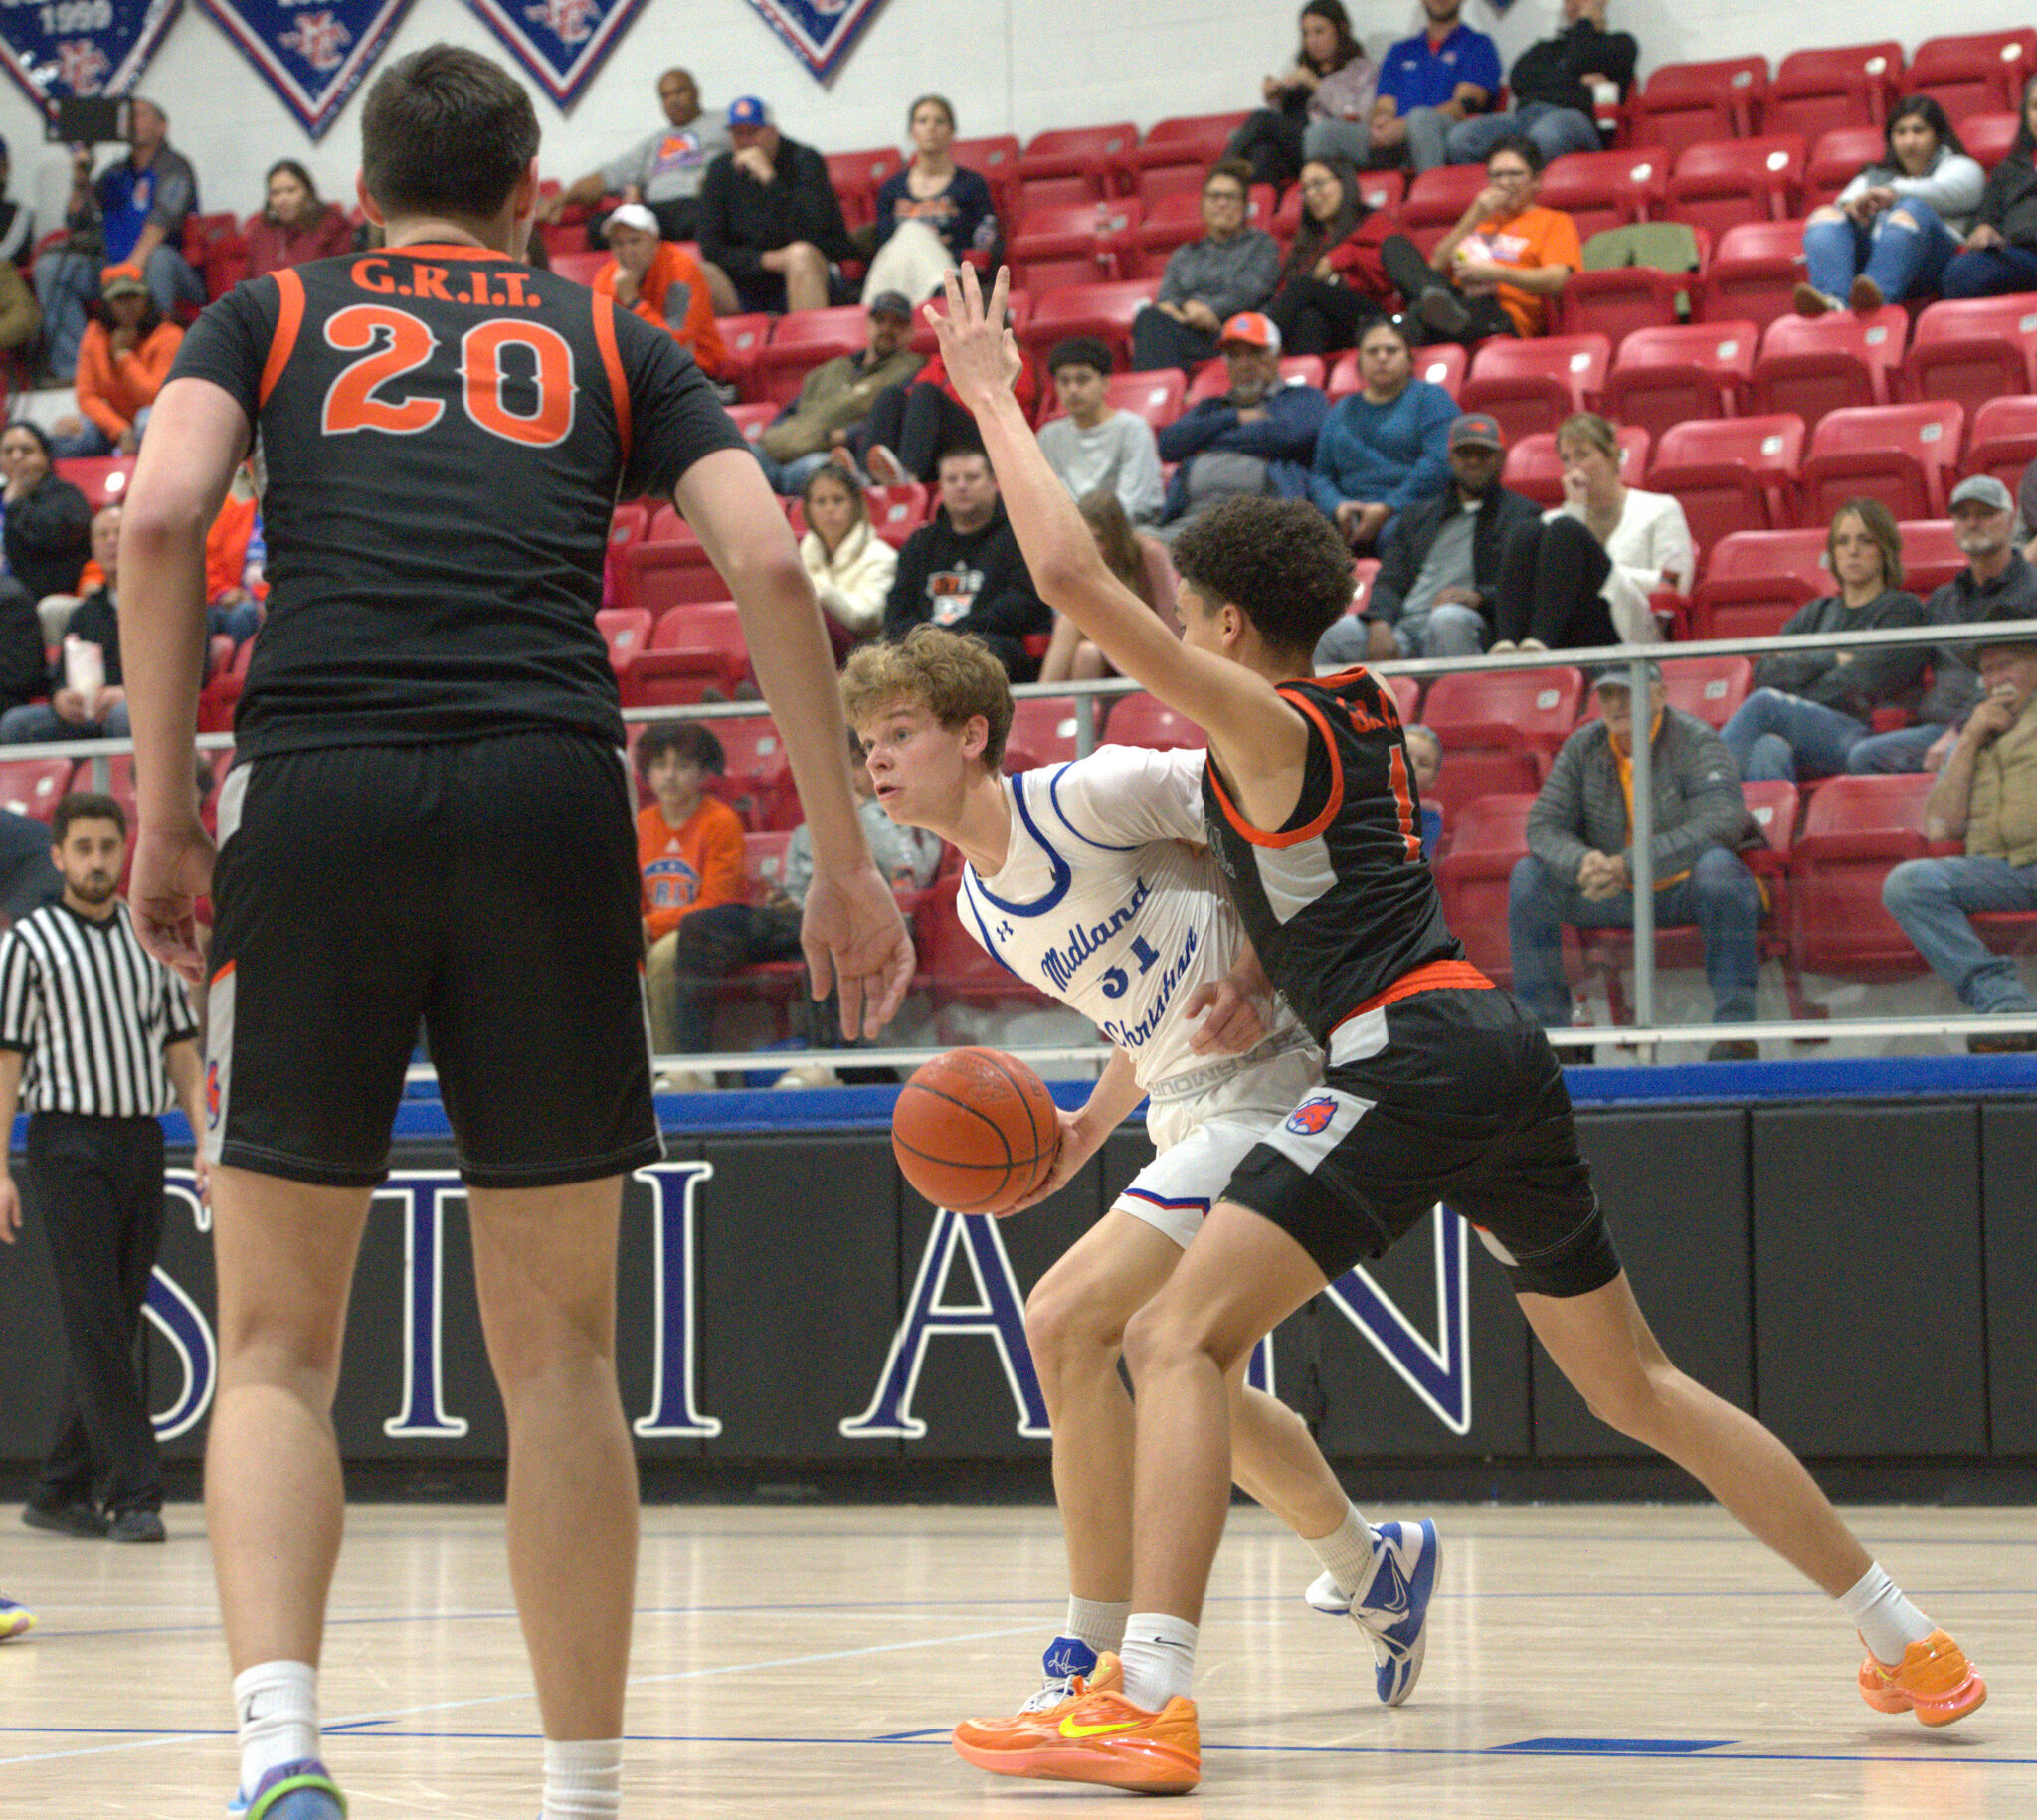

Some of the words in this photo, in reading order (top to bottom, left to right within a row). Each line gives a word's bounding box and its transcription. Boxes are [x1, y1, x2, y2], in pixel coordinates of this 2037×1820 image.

[351, 258, 541, 306] G.R.I.T.
[321, 303, 580, 448] 20
[1388, 743, 1421, 864] 1
[1041, 876, 1155, 993] Midland
[1097, 935, 1160, 999] 31
[1104, 926, 1197, 1048] Christian
